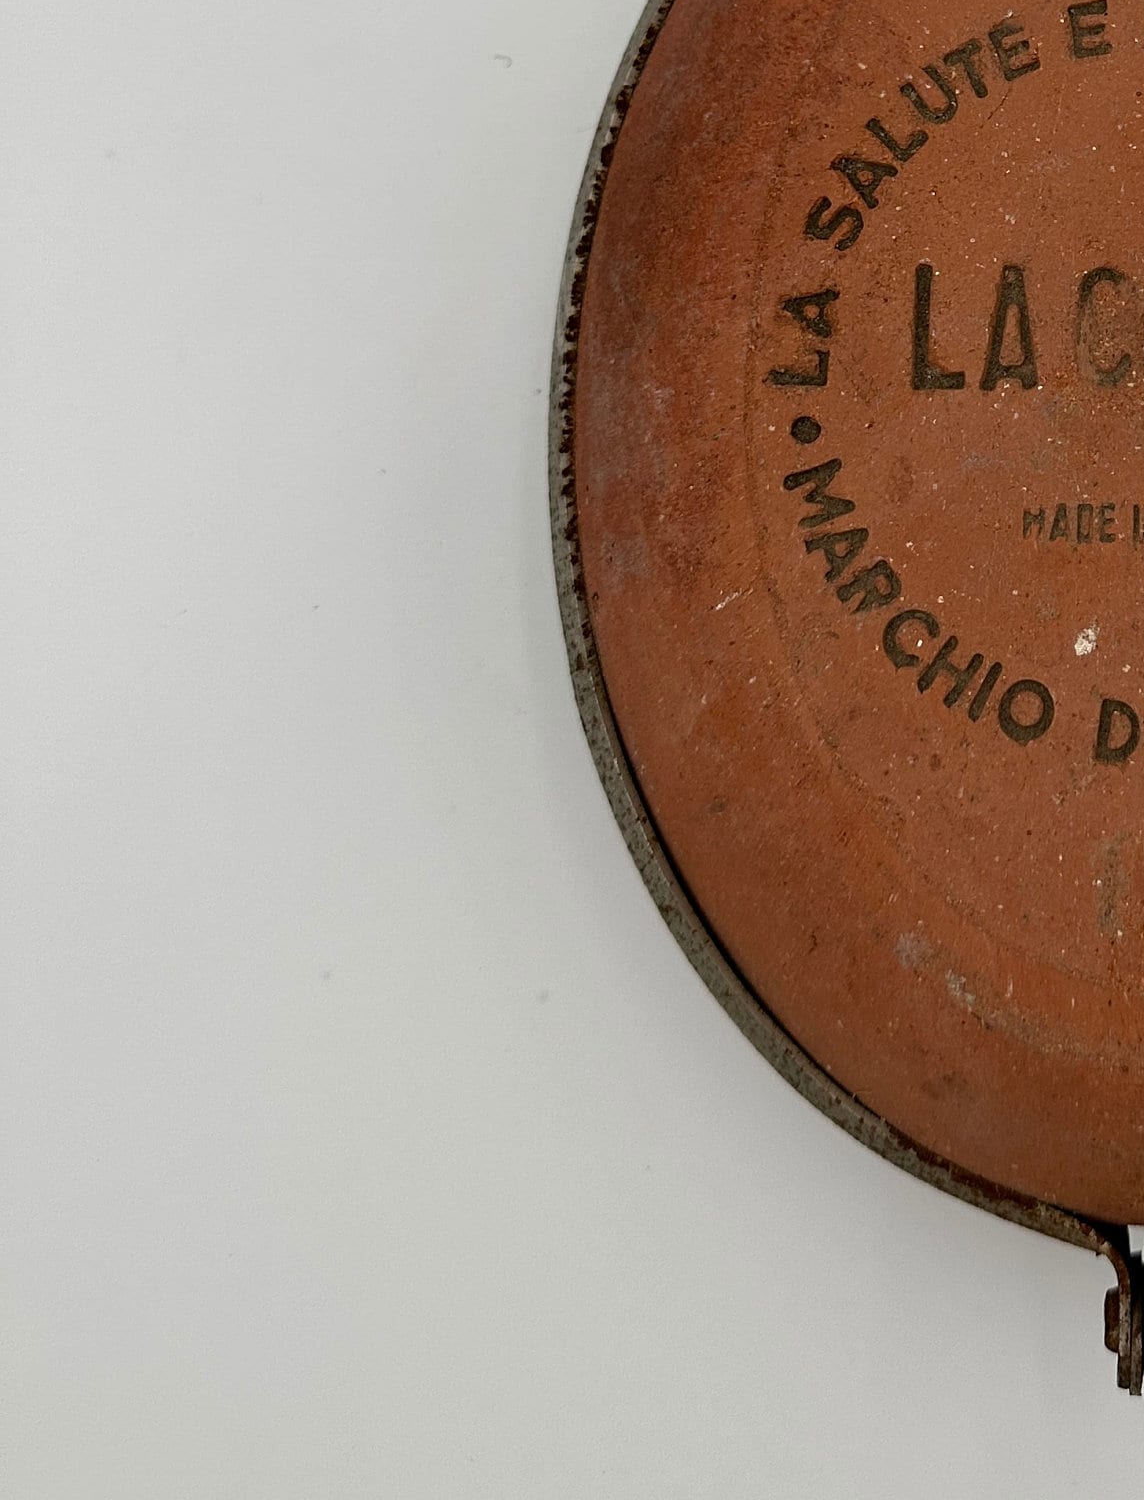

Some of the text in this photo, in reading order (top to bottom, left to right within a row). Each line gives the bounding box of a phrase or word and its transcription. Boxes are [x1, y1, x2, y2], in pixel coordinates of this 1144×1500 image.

[766, 288, 840, 387] LA
[804, 21, 1041, 251] SALUTE
[1067, 0, 1113, 59] E
[912, 263, 1038, 390] LA
[783, 458, 1055, 746] MARCHIO
[1022, 502, 1116, 544] MADE
